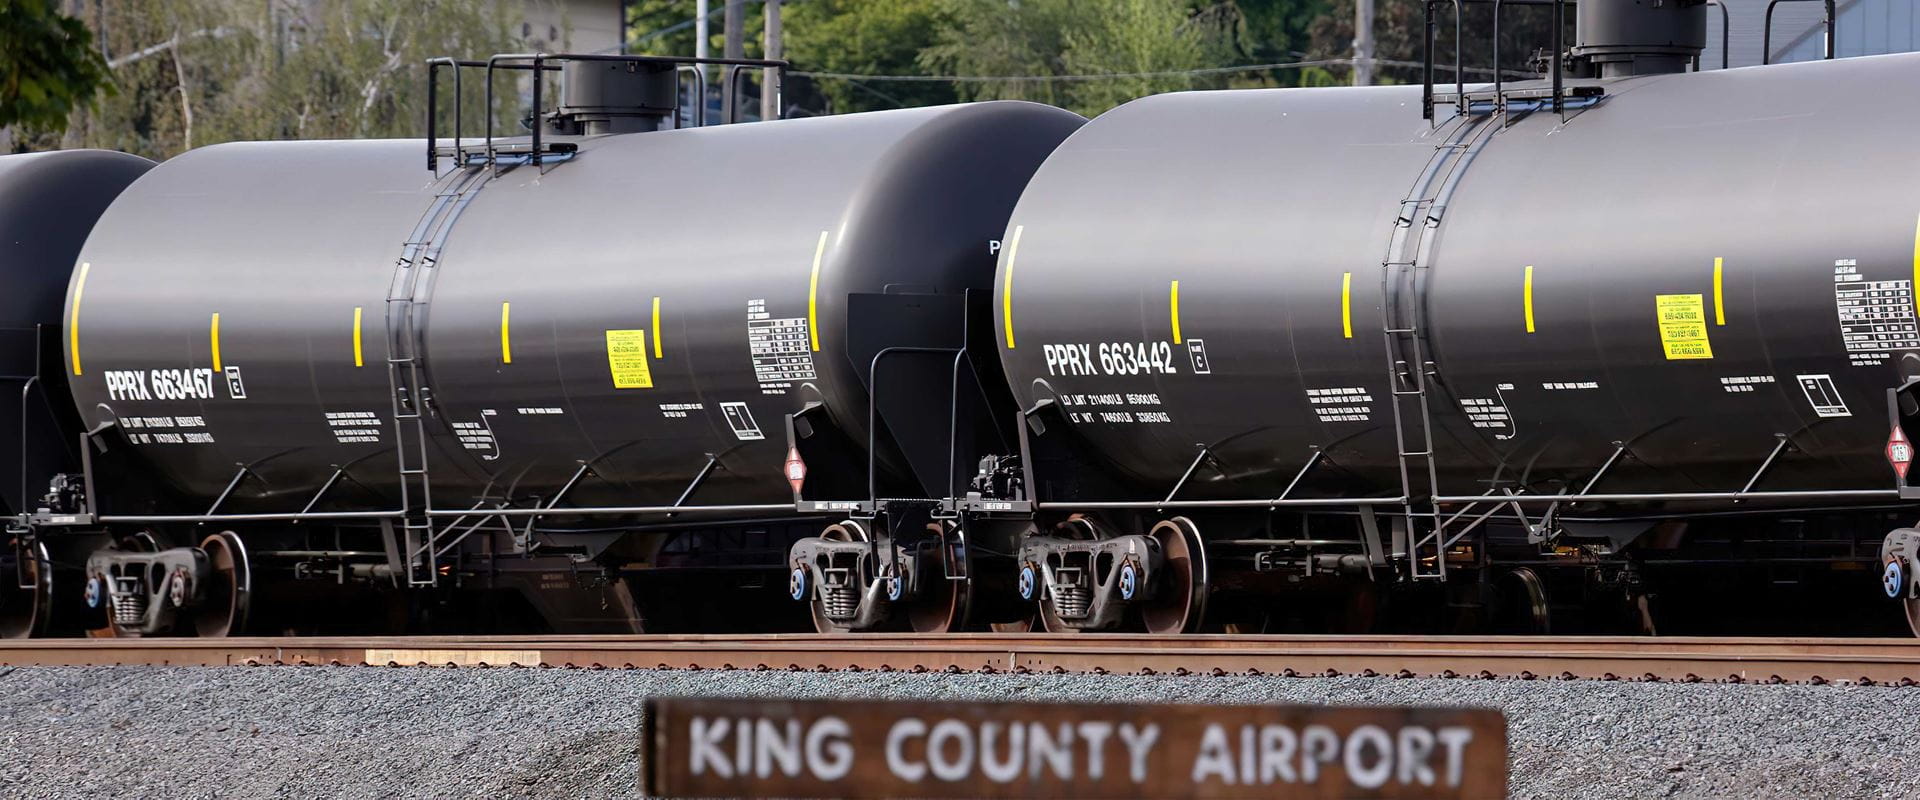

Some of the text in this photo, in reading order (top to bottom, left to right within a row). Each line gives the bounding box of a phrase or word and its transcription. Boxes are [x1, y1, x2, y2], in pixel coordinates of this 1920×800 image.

[1042, 341, 1177, 376] PPRX 663442
[1196, 355, 1204, 368] C
[104, 368, 214, 400] PPRX 663467
[232, 381, 240, 394] C
[1060, 395, 1073, 406] LD
[1069, 413, 1080, 423] LT
[689, 716, 1474, 788] KING COUNTY AIRPORT
